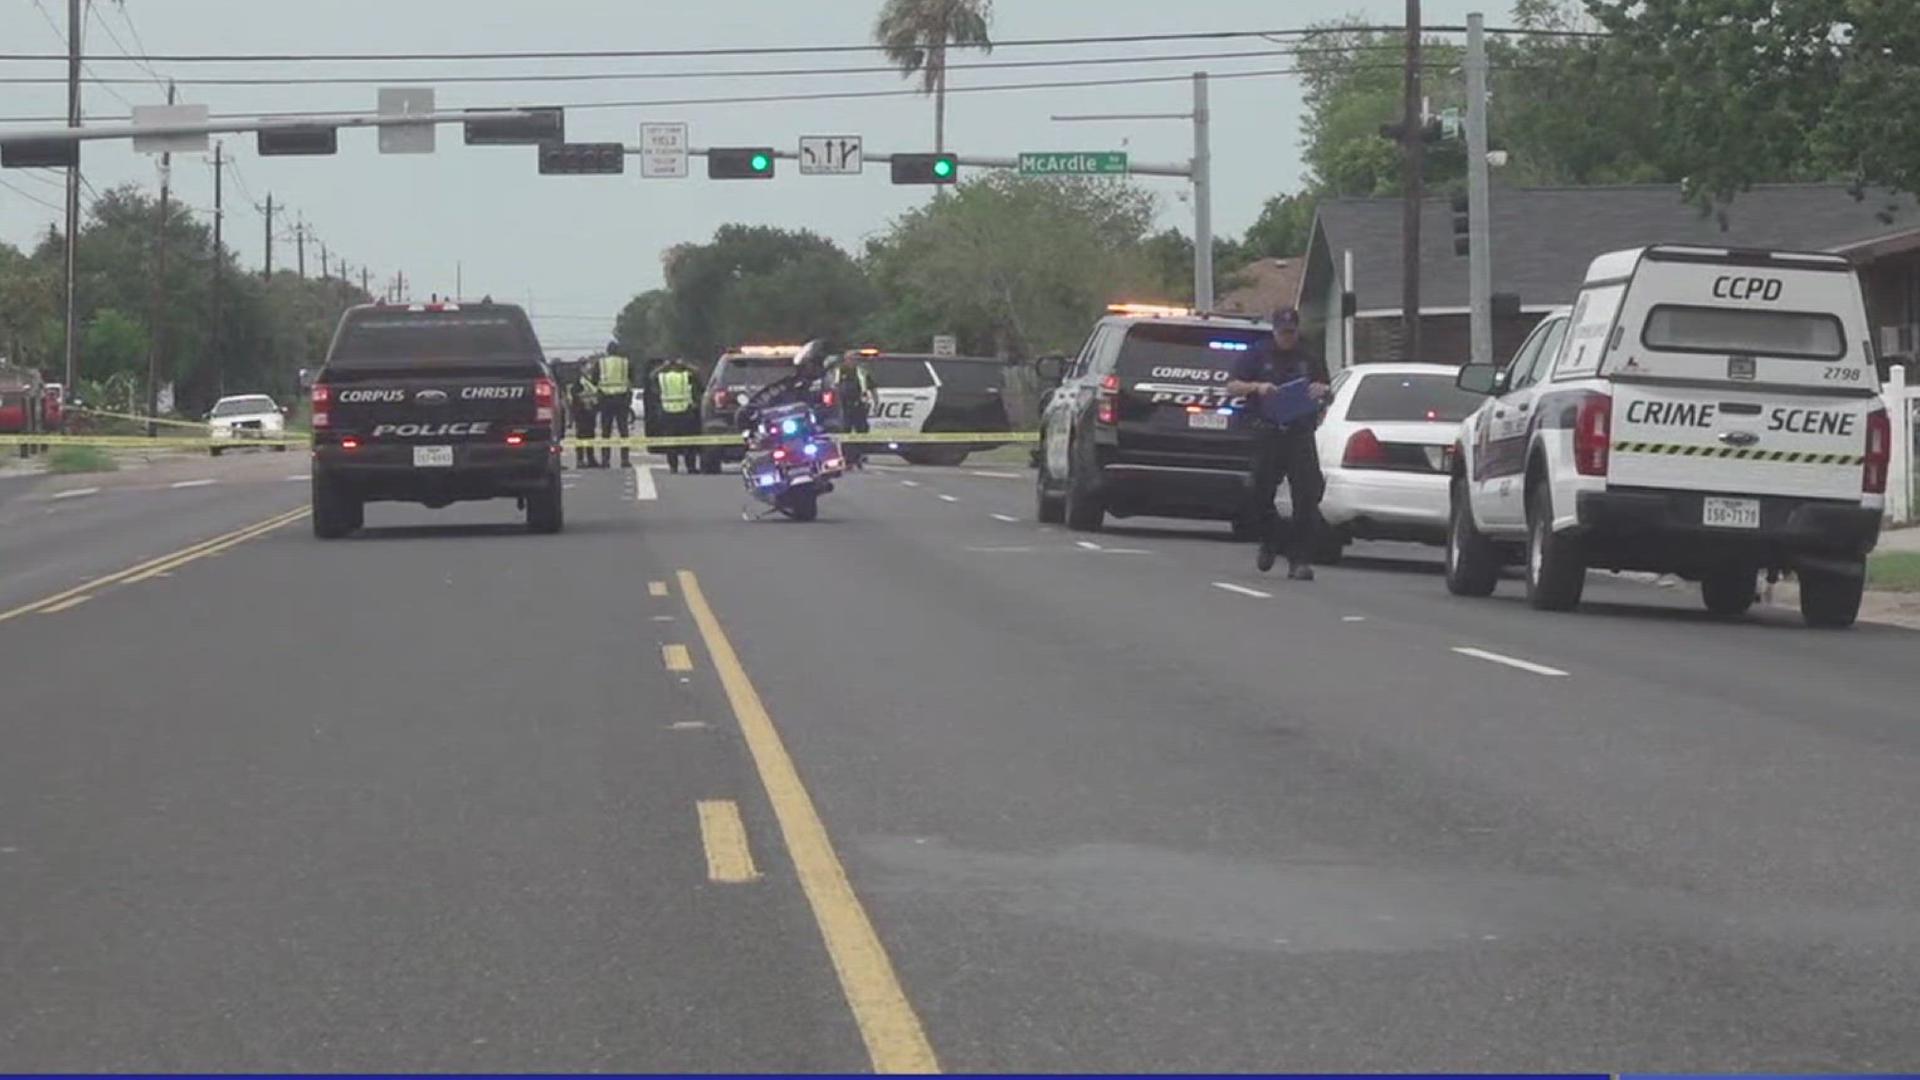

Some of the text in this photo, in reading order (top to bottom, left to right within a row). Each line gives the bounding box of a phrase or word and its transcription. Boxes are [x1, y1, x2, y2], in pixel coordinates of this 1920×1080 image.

[1021, 155, 1097, 171] McArdle
[1712, 275, 1783, 301] CCPD
[1151, 366, 1211, 381] CORPUS
[1823, 366, 1861, 381] 2798
[339, 386, 525, 402] CORPUS CHRISTI
[1151, 393, 1247, 407] POLIC
[1626, 400, 1856, 436] CRIME SCENE
[372, 421, 492, 437] POLICE
